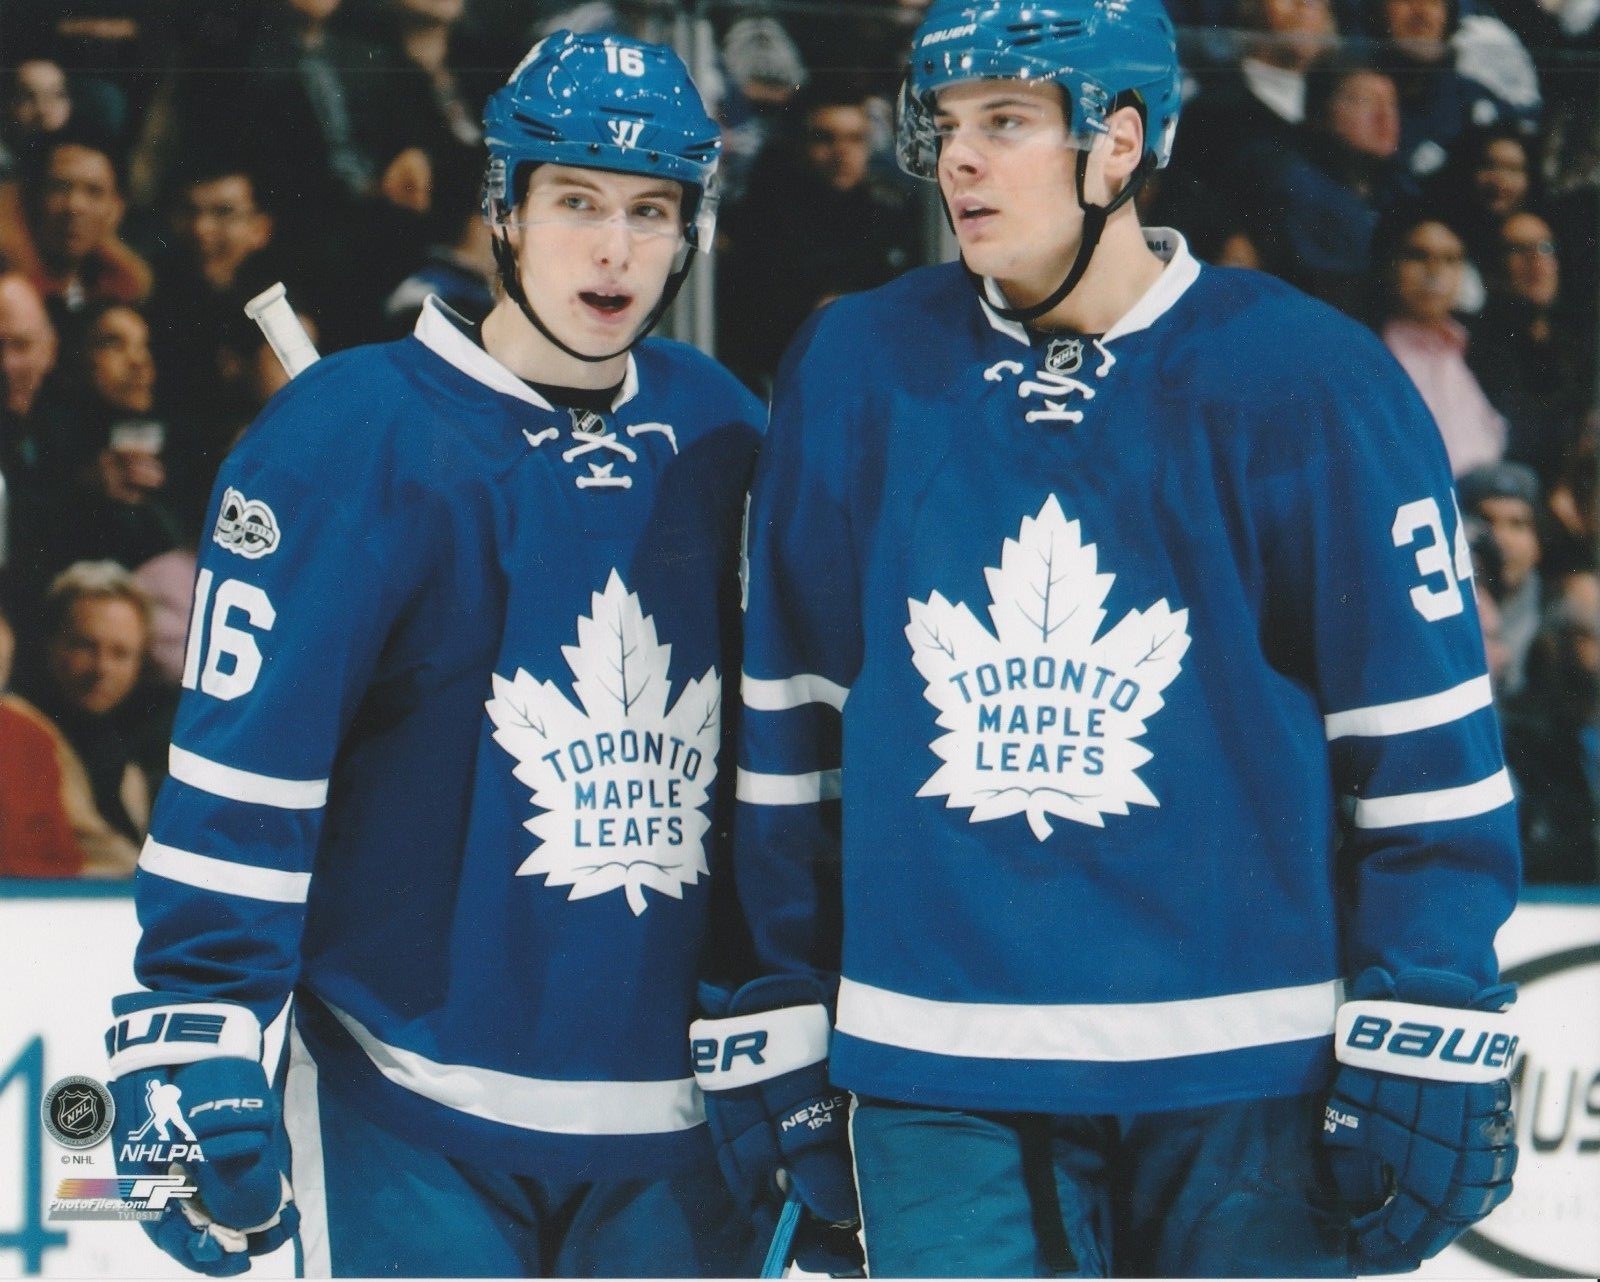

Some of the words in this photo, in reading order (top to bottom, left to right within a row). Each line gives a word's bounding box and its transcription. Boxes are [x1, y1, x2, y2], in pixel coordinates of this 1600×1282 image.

[603, 46, 645, 77] 16
[182, 567, 276, 701] 16
[949, 656, 1141, 713] TORONTO
[978, 703, 1106, 738] MAPLE
[541, 729, 702, 783] TORONTO
[976, 741, 1105, 776] LEAFS
[574, 778, 682, 810] MAPLE
[574, 816, 683, 847] LEAFS
[1345, 1014, 1520, 1068] BAUER
[781, 1096, 844, 1132] NEXUS
